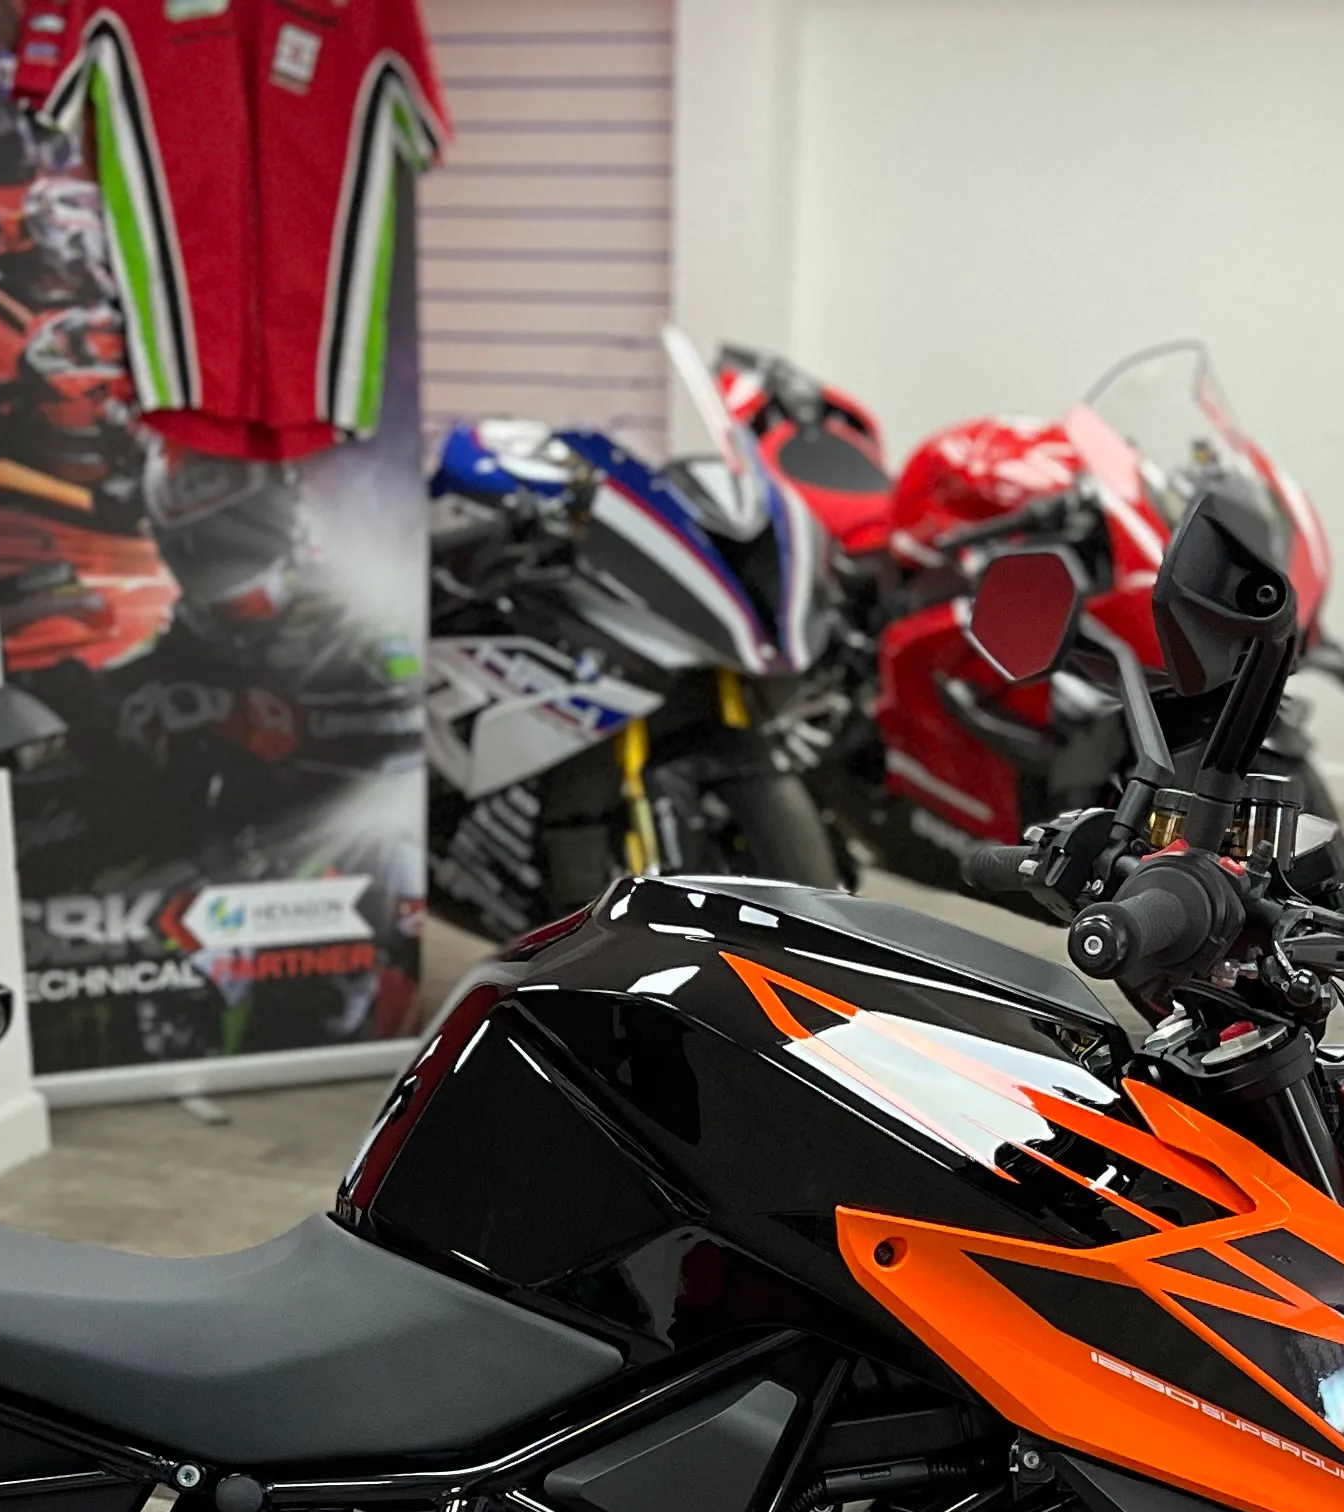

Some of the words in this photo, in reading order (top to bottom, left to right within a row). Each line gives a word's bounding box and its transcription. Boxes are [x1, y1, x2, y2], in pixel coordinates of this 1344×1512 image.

[25, 960, 205, 1003] ECHNICAL
[210, 944, 377, 986] PARTNER
[1090, 1351, 1199, 1410] 1290
